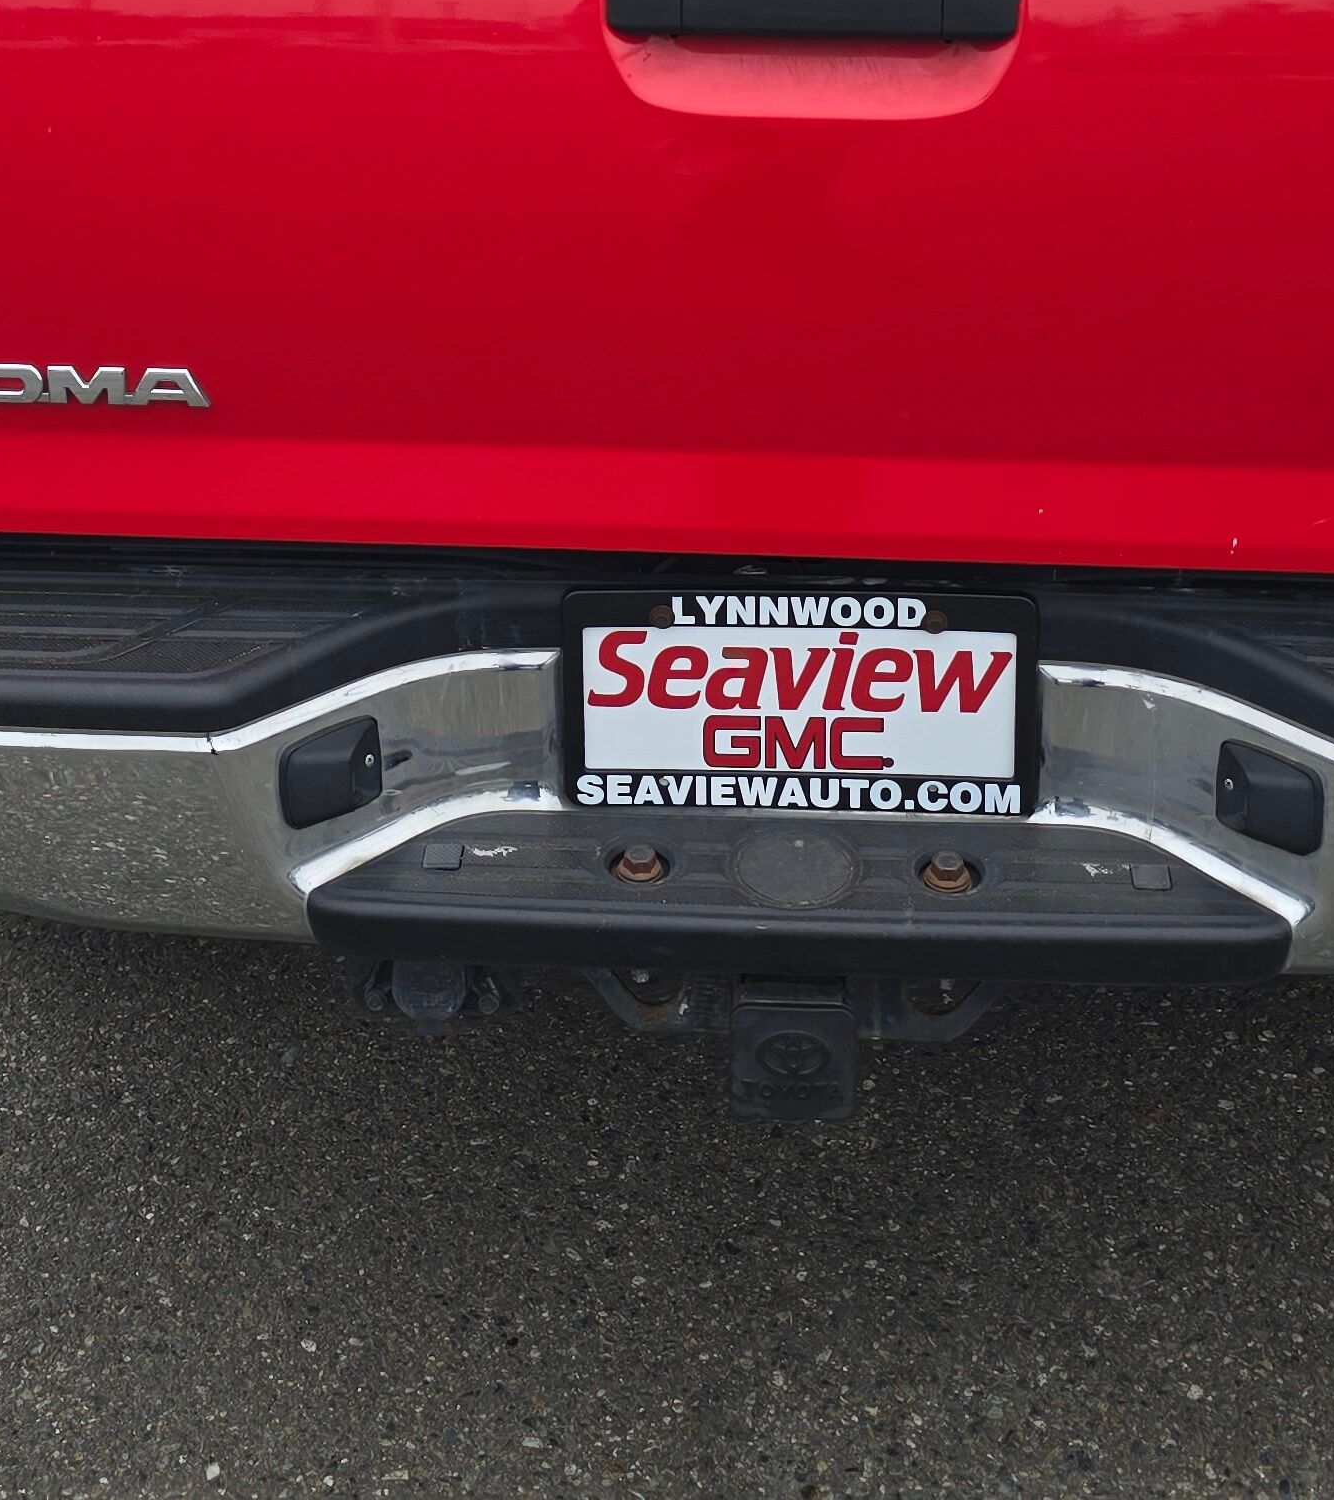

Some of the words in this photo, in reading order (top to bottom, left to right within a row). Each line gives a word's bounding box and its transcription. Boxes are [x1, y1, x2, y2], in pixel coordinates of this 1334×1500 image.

[671, 596, 927, 627] LYNNWOOD
[587, 630, 1013, 713] Seaview
[703, 714, 889, 771] GMC
[576, 775, 1021, 814] SEAVIEWAUTO.COM
